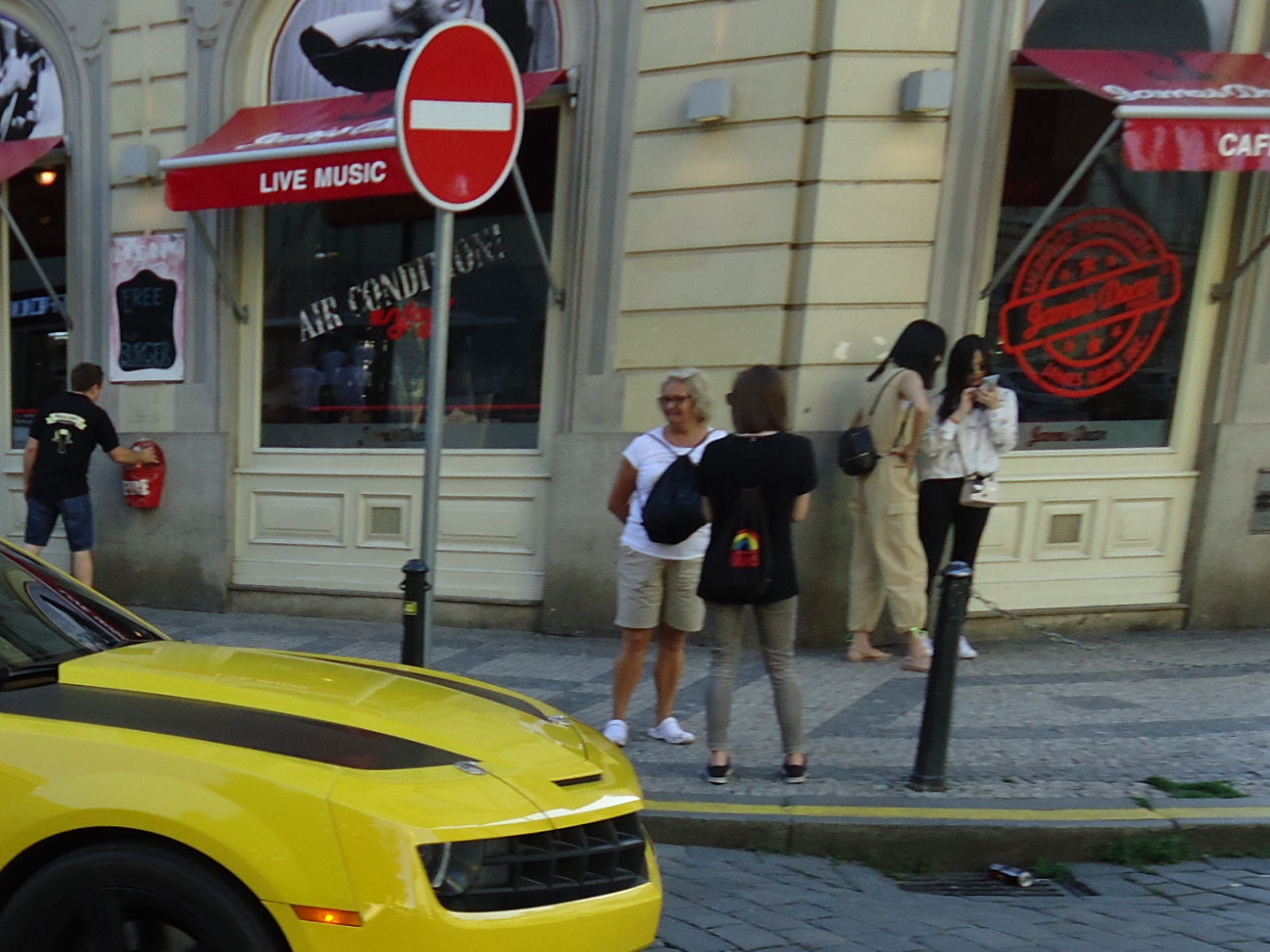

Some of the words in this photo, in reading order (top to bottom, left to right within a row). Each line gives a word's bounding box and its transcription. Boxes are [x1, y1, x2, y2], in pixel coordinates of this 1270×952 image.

[1218, 132, 1270, 157] CAF
[259, 169, 308, 193] LIVE
[314, 160, 388, 189] MUSIC
[299, 296, 344, 343] AIR
[347, 223, 507, 318] CONDION!
